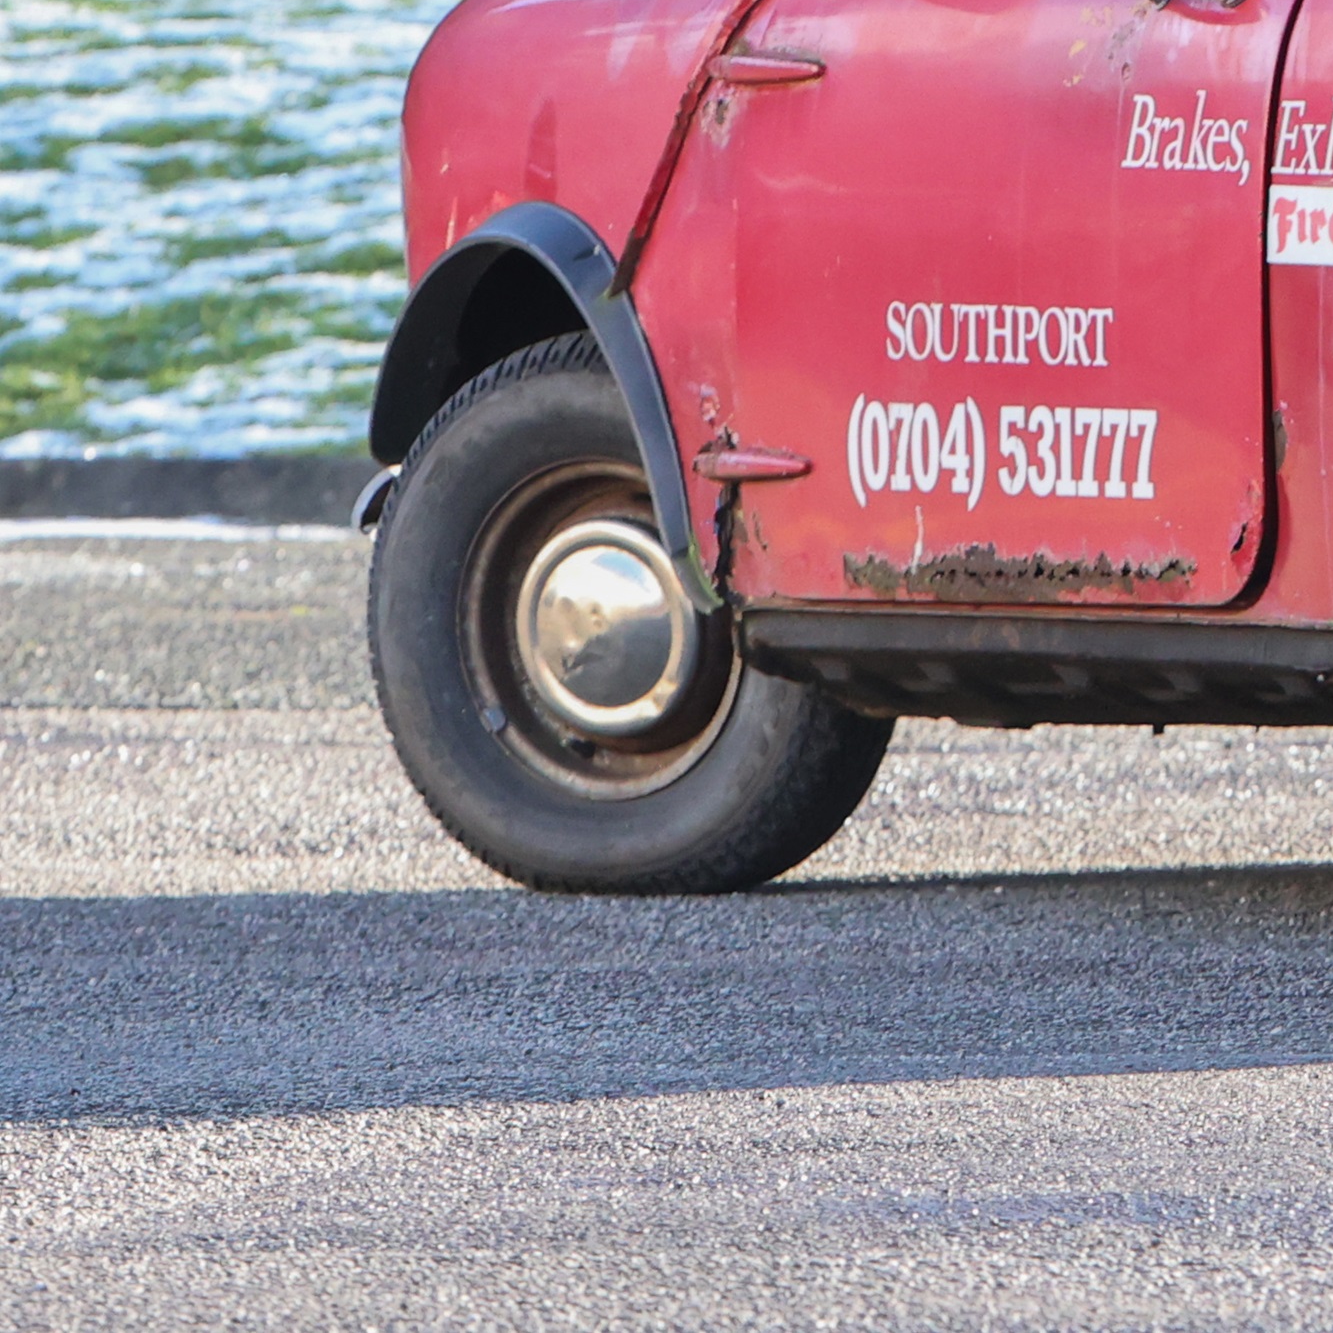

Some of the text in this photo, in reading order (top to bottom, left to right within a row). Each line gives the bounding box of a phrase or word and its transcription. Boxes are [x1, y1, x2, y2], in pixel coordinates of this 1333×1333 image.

[1121, 90, 1251, 186] Brakes,
[886, 300, 1114, 367] SOUTHPORT
[847, 392, 1158, 512] (0704) 531777
